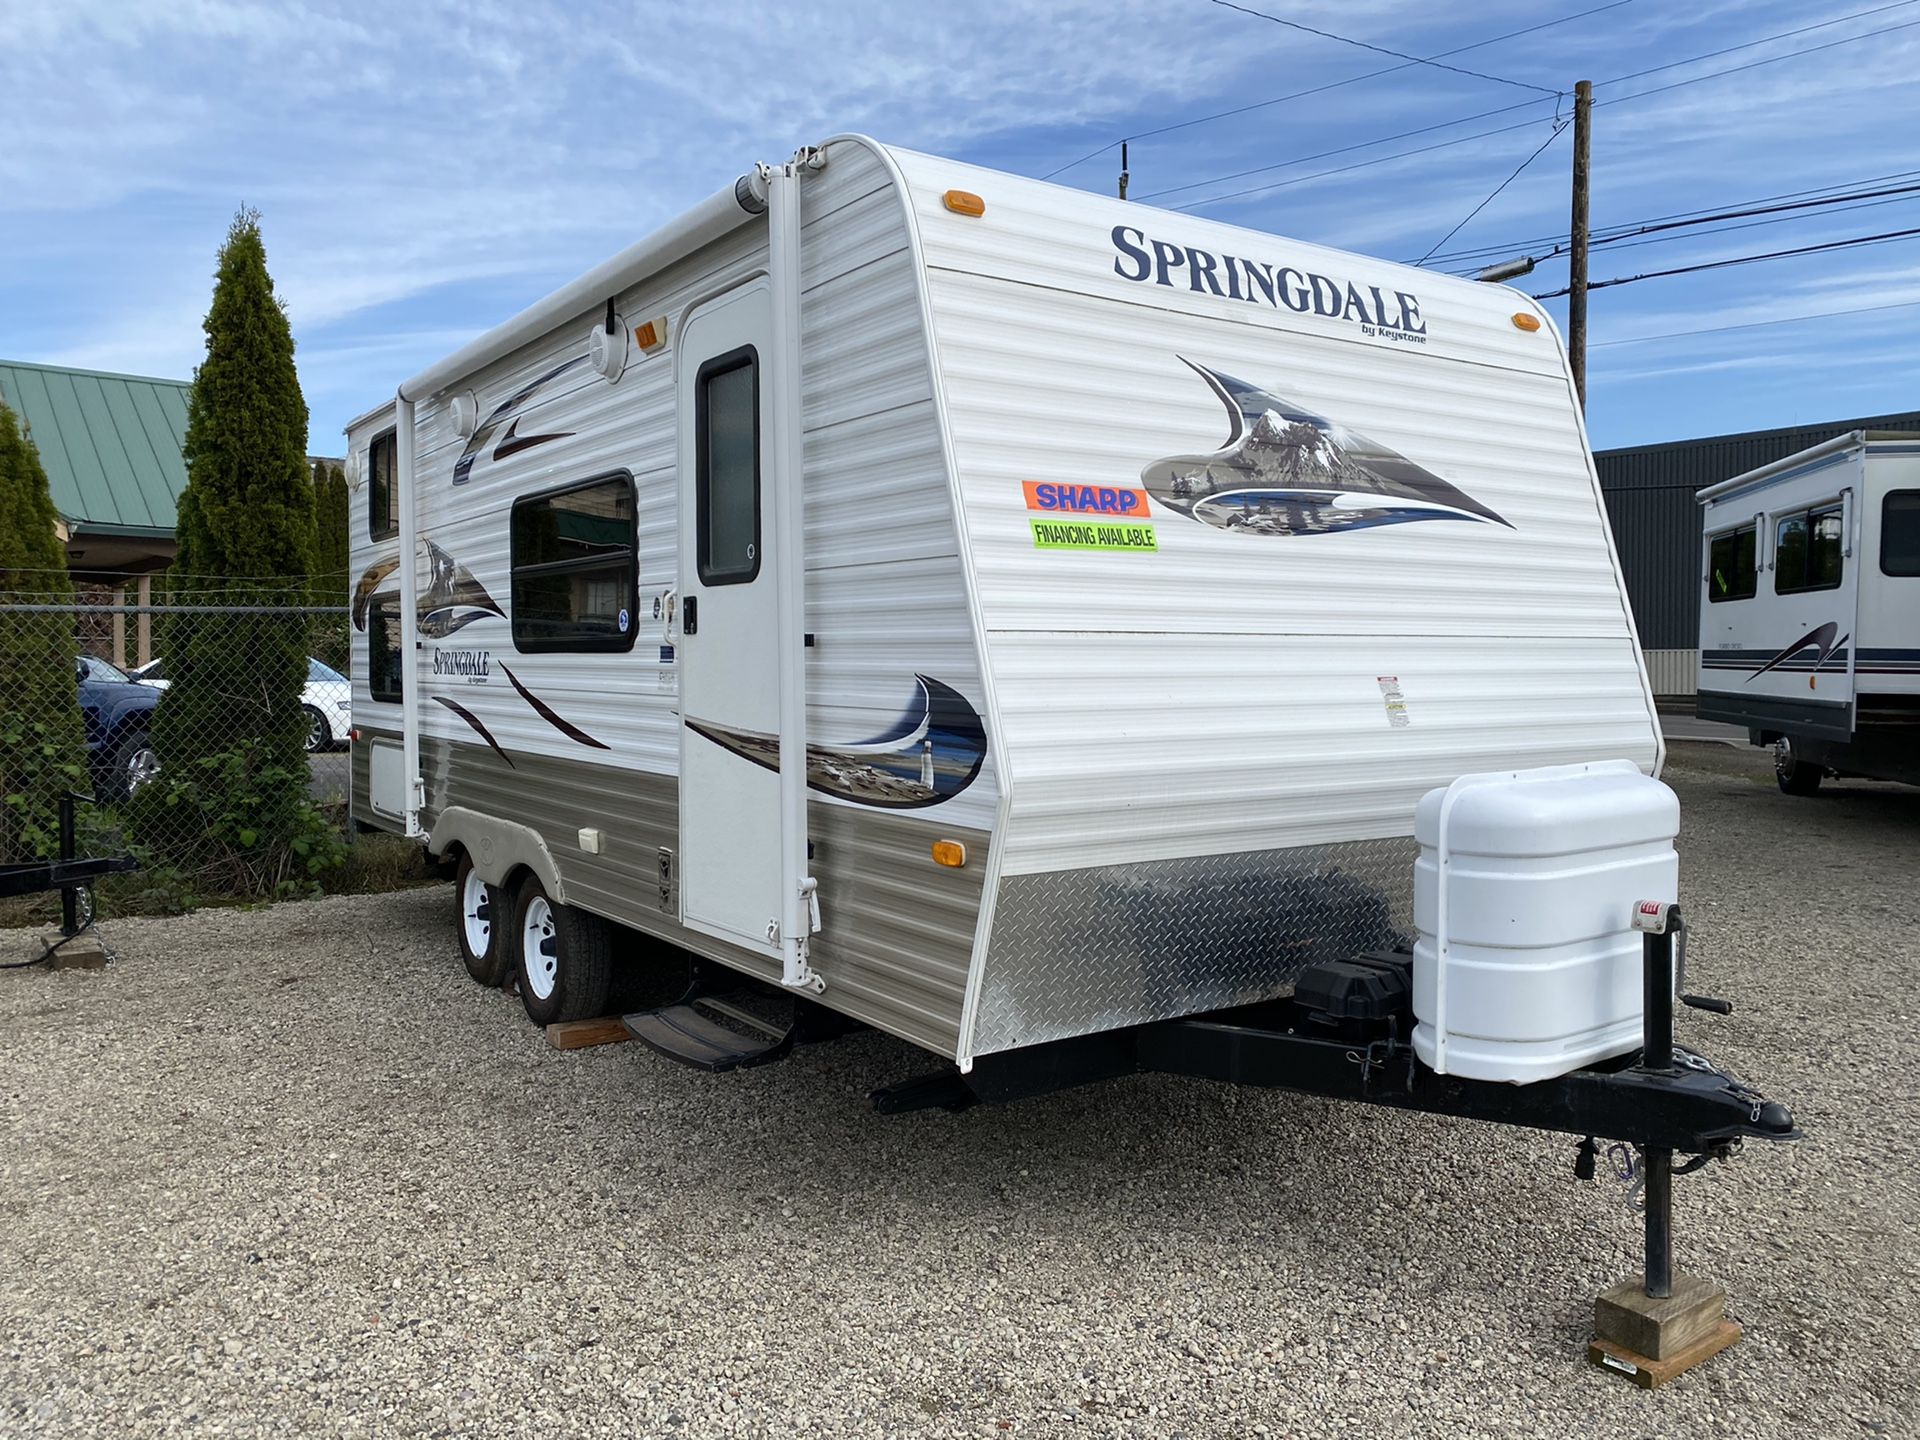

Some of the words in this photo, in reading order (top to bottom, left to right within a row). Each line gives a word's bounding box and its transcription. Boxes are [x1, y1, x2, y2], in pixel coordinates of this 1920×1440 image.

[1111, 225, 1427, 334] SPRINGDALE
[1361, 324, 1375, 337] by
[1378, 327, 1427, 344] Keystone
[1036, 483, 1138, 513] SHARP
[1034, 524, 1096, 545] FINANCING
[1098, 527, 1155, 547] AVAILABLE
[433, 647, 490, 676] SPRINGDALE
